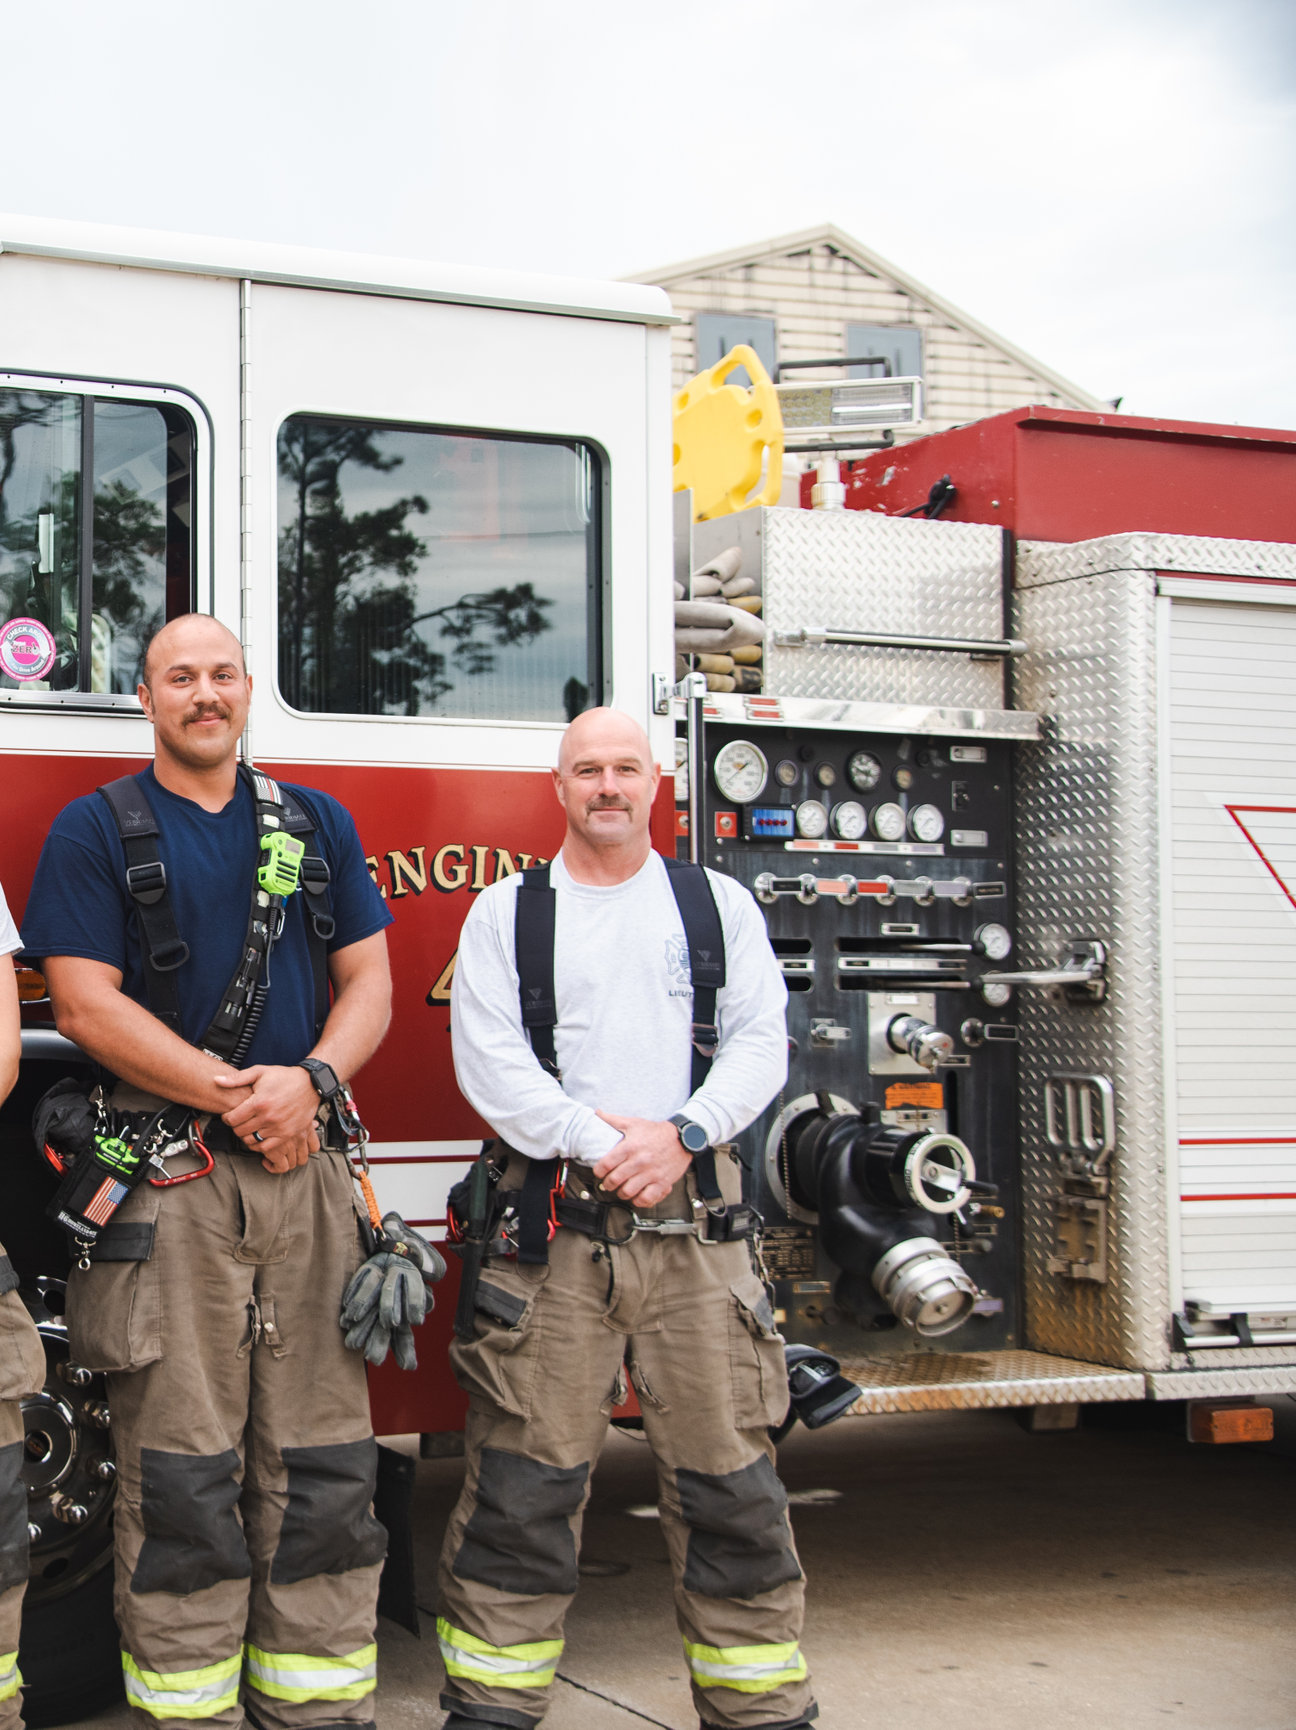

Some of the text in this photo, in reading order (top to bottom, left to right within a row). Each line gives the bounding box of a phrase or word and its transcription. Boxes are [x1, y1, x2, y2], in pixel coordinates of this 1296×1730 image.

[7, 626, 28, 640] CHECK
[365, 844, 549, 899] NGIN
[669, 990, 694, 998] LIEUT
